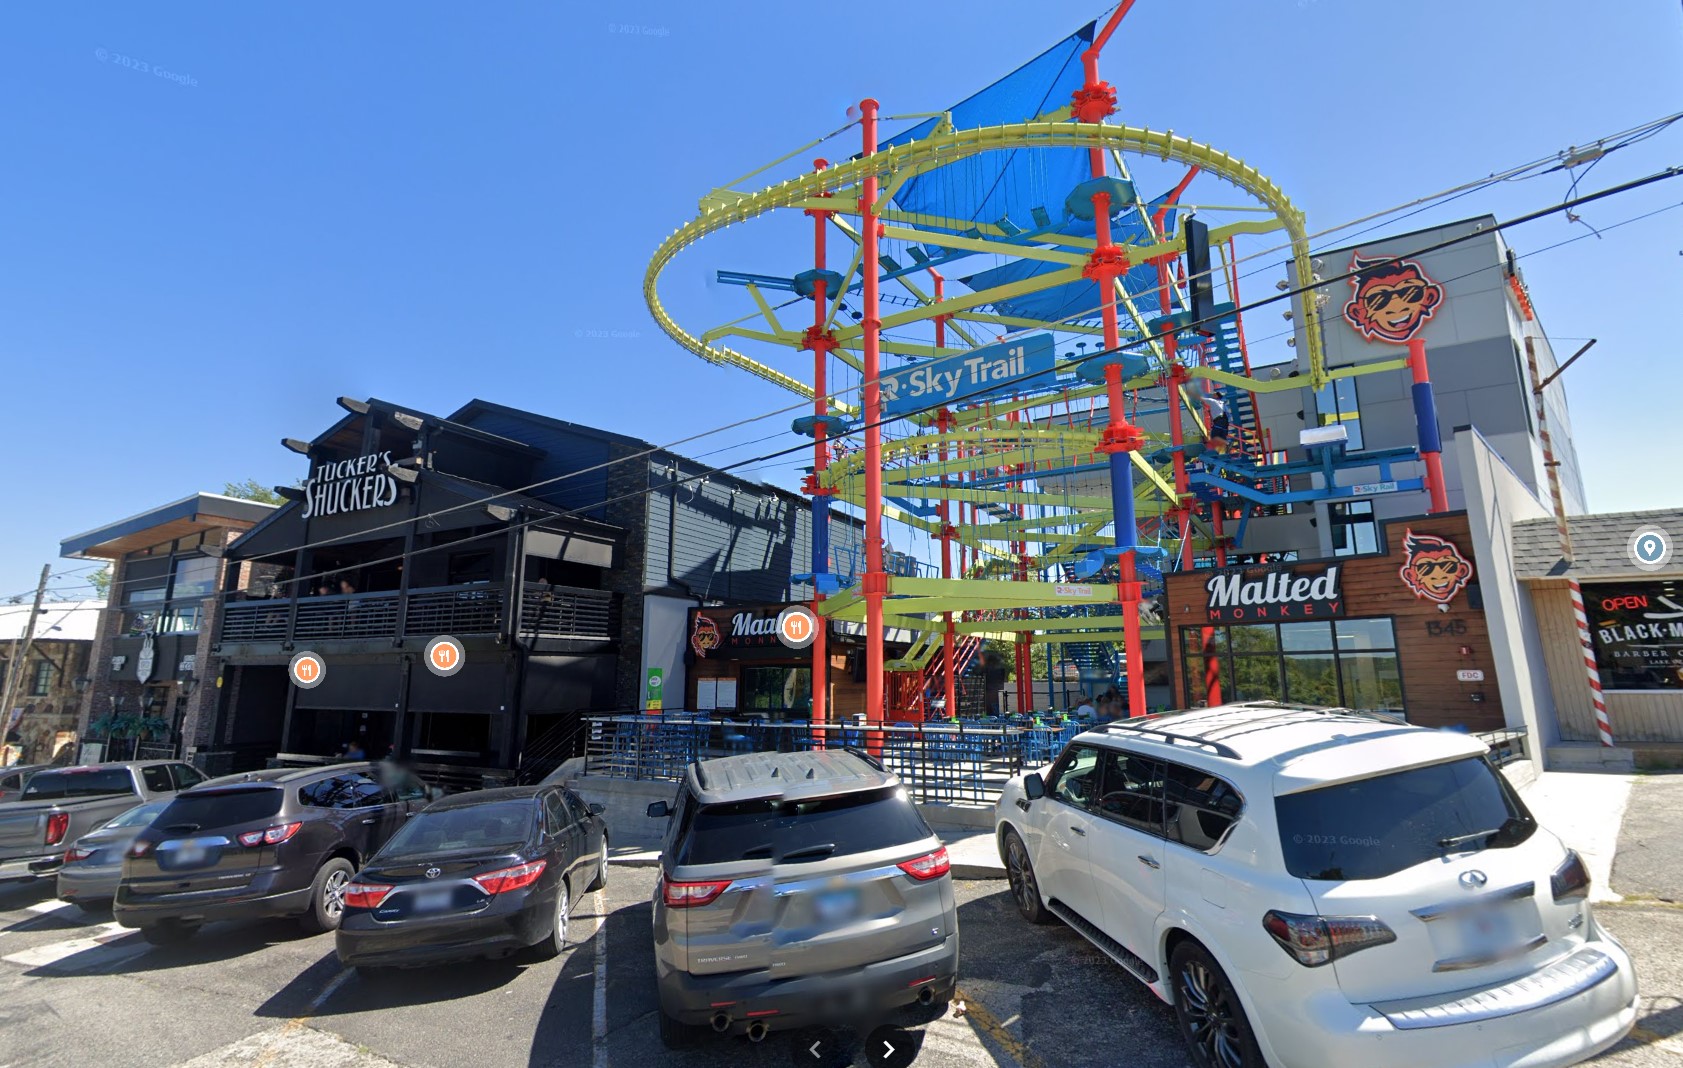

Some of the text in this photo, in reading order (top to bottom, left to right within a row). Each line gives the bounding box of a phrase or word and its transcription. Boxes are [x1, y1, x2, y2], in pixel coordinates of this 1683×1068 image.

[910, 367, 963, 398] Sky
[964, 346, 1025, 385] Trail
[317, 450, 392, 483] TUCKER'S
[301, 463, 398, 519] SHUCKERS
[1207, 566, 1339, 608] Malted
[1602, 595, 1648, 611] OPEN
[1209, 602, 1339, 620] MONKEY
[1614, 650, 1669, 658] BARBER
